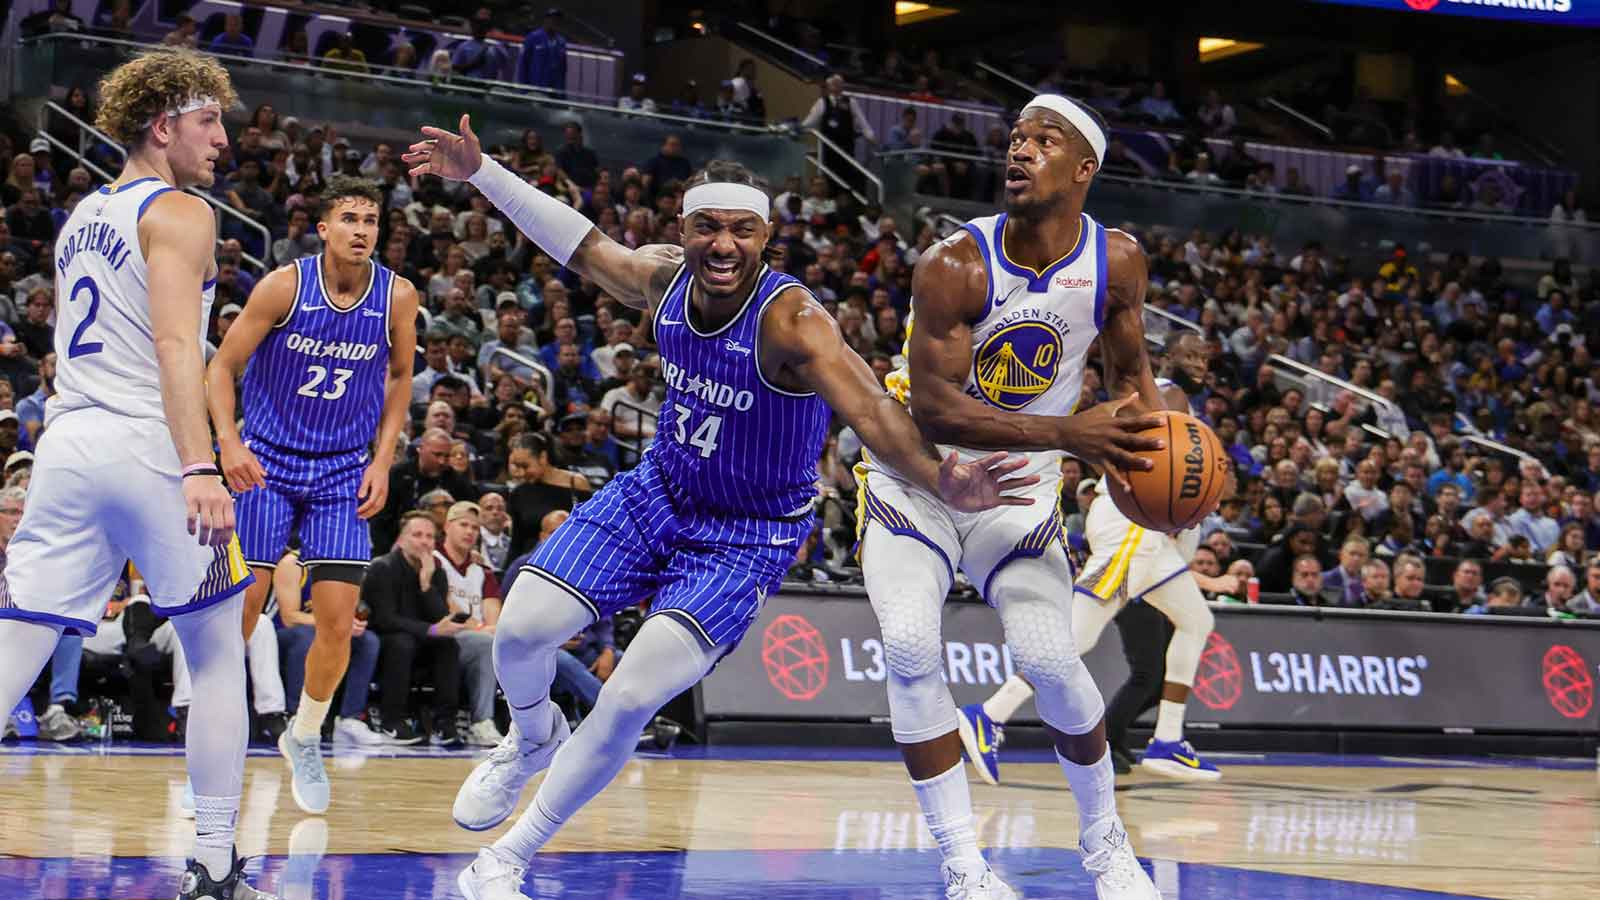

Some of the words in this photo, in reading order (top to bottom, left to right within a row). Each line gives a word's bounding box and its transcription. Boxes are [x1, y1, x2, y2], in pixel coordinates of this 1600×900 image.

[1055, 276, 1093, 288] Rakuten
[68, 275, 104, 359] 2
[1044, 311, 1071, 337] STATE
[1032, 343, 1055, 368] 10
[296, 364, 355, 401] 23
[673, 402, 723, 459] 34
[1180, 421, 1206, 500] Wilson
[840, 637, 1015, 685] L3RRI
[1250, 651, 1422, 697] L3HARRIS
